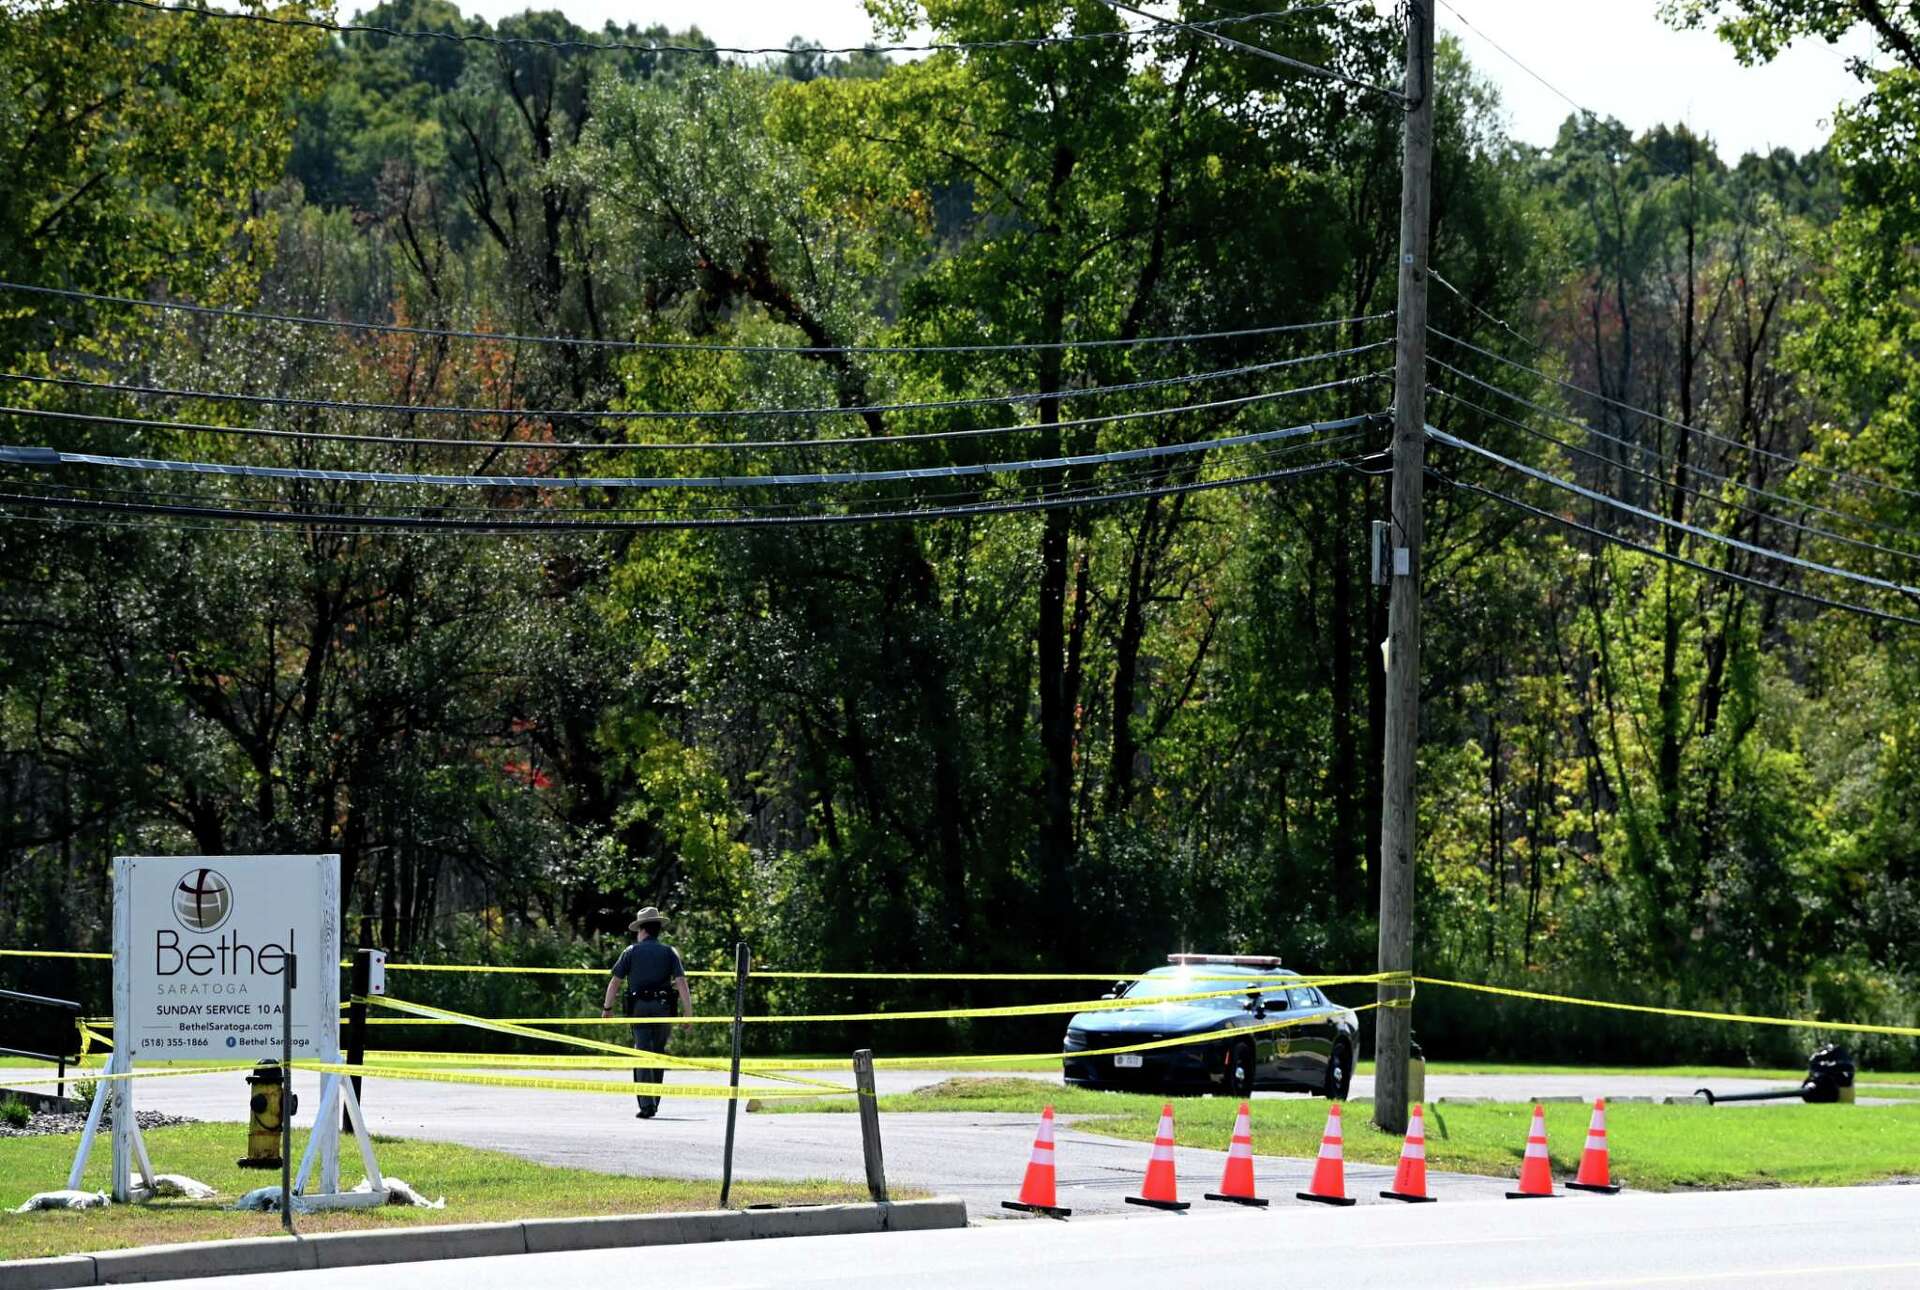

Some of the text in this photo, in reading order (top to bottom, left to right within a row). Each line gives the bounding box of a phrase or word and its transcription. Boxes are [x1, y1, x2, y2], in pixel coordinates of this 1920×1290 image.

[156, 928, 294, 976] Bethel
[157, 983, 248, 995] SARATOGA
[156, 1004, 285, 1015] SUNDAY SERVICE 10 A
[179, 1022, 273, 1033] BethelSaratoga.com
[141, 1038, 209, 1048] (518) 355-1866
[239, 1037, 268, 1046] Bethel
[270, 1037, 310, 1047] Saroga
